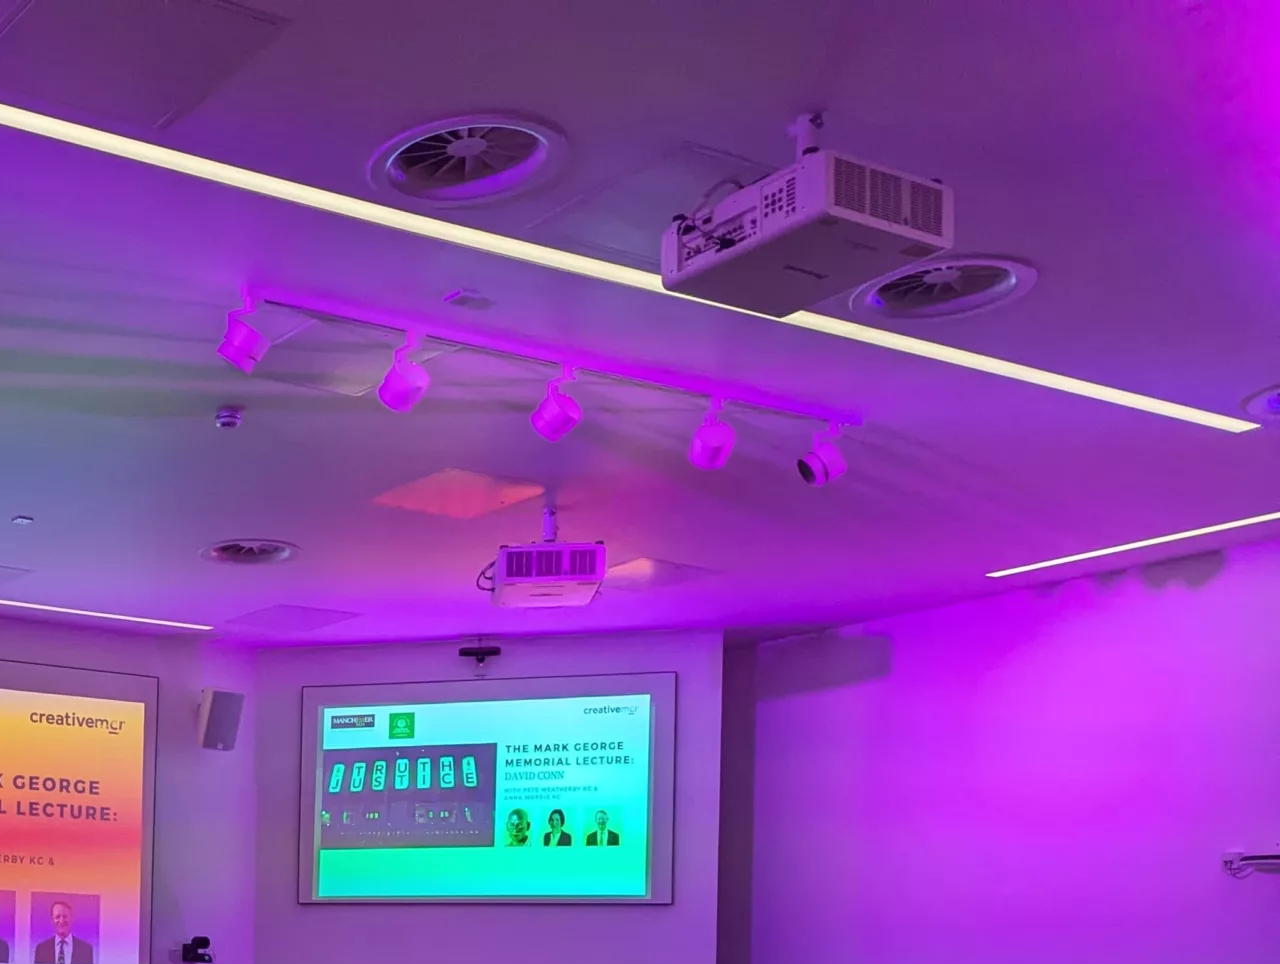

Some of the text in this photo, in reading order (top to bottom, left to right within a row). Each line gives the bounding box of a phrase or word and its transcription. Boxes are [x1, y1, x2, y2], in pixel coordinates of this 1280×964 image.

[583, 704, 639, 716] creativemcr
[29, 711, 126, 733] creativemcr
[505, 741, 625, 754] THE MARK GEORGE
[505, 755, 635, 768] MEMORIAL LECTURE:
[504, 770, 566, 781] DAVID CONN
[12, 774, 101, 796] GEORGE
[16, 800, 119, 822] LECTURE:
[29, 856, 45, 867] KC
[48, 857, 56, 866] &
